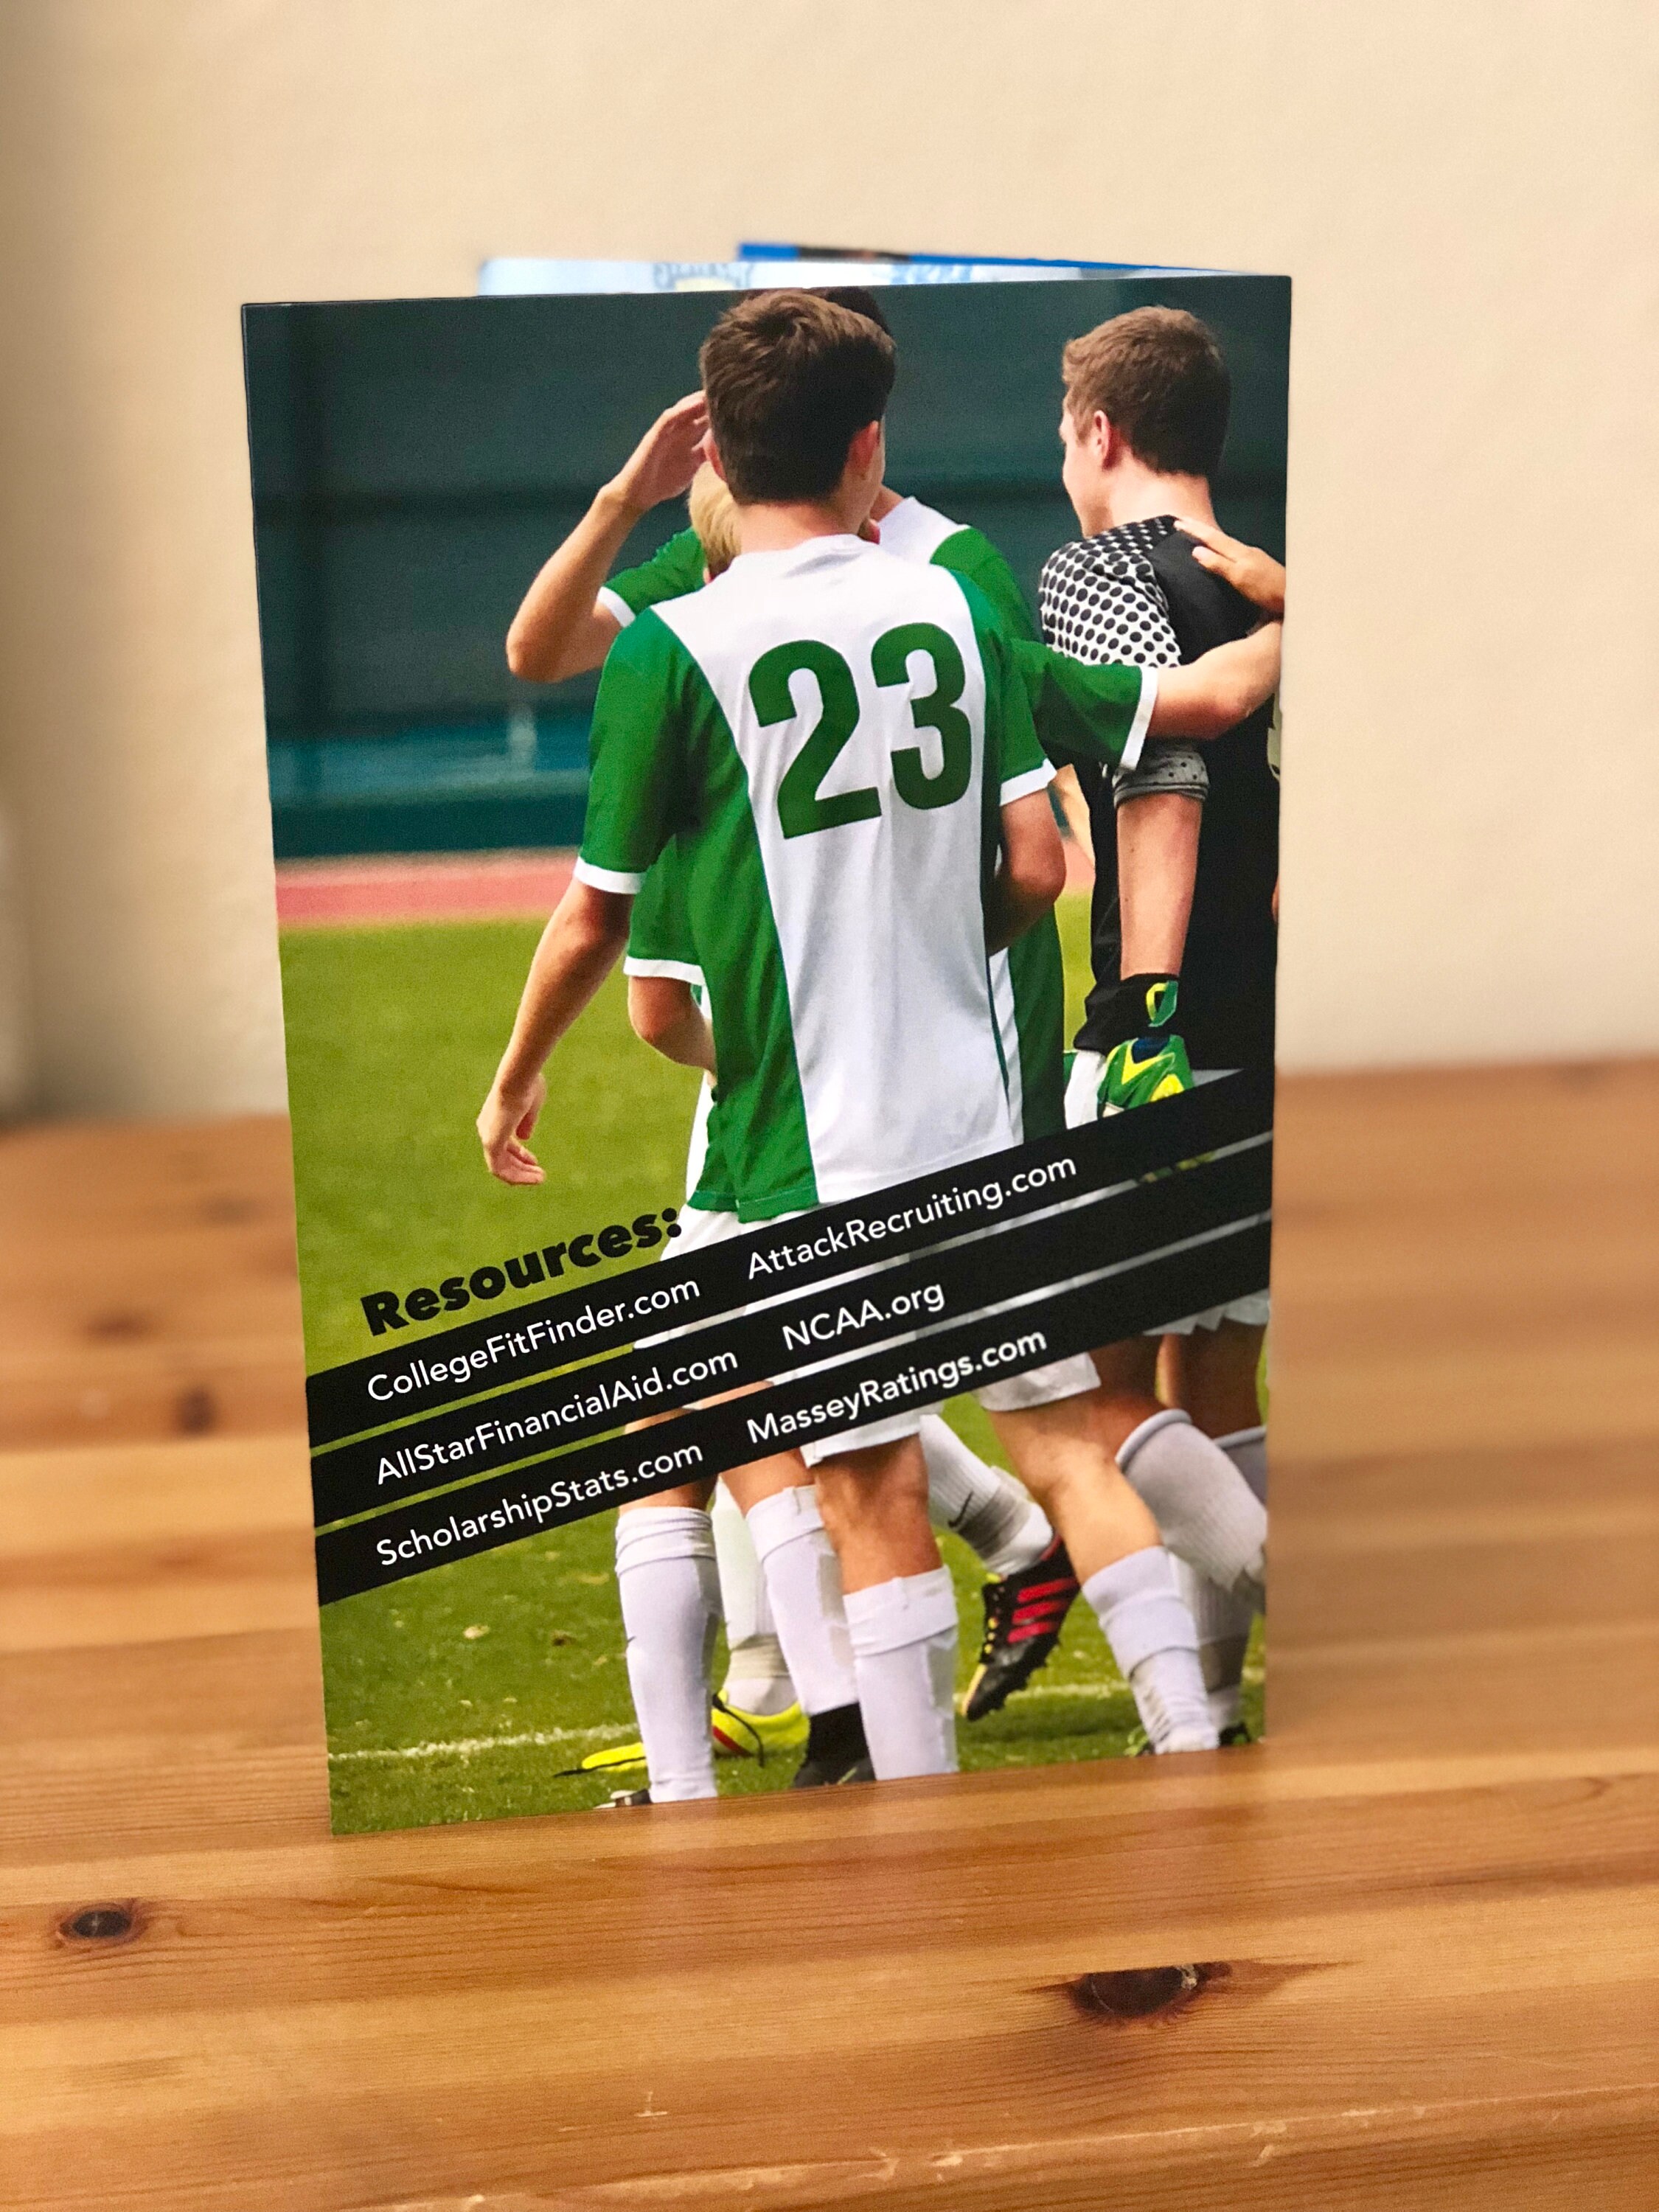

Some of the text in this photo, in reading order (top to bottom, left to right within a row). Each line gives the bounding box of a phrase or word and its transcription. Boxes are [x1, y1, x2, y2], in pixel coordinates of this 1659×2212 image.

[749, 622, 973, 840] 23
[361, 1208, 682, 1336] Resources:
[368, 1158, 1077, 1400] CollegeFitFinder.com AttackRecruiting.com
[377, 1284, 945, 1485] AllStarFinancialAid.com NCAA.org
[377, 1332, 1047, 1565] ScholarshipStats.com MasseyRatings.com
